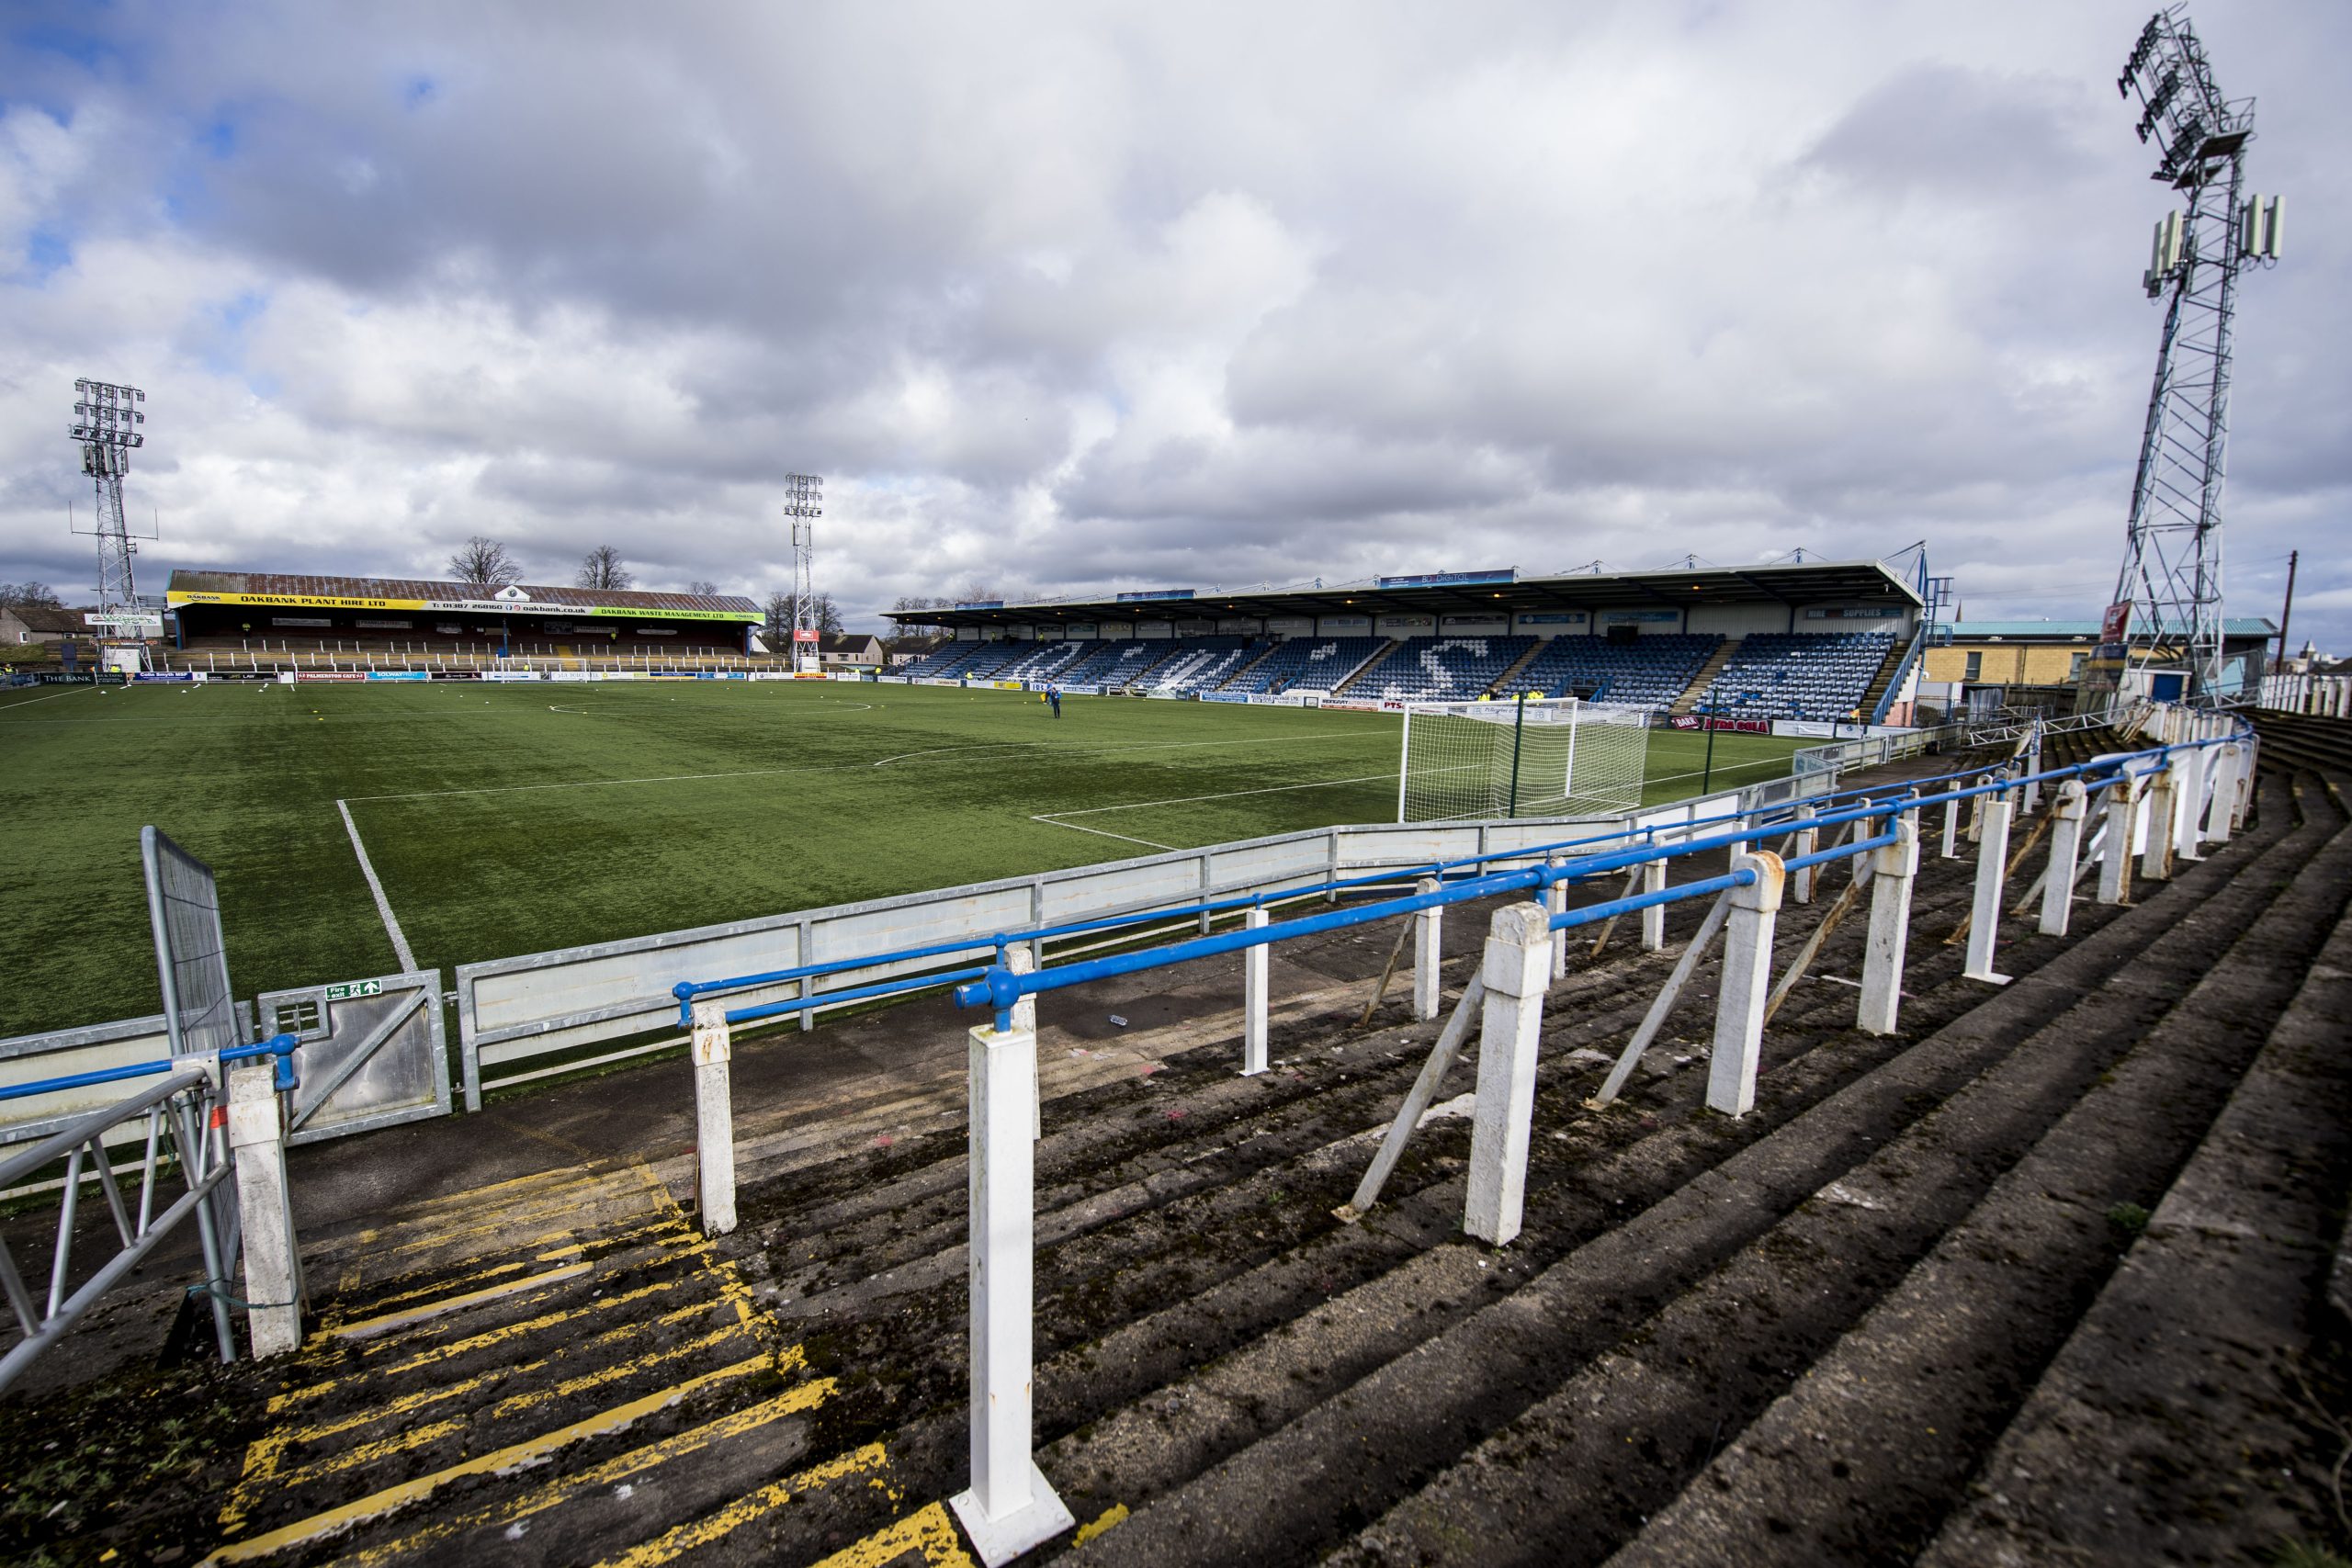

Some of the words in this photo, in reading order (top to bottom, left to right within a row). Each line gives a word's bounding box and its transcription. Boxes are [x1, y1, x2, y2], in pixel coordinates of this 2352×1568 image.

[241, 595, 297, 604] OAKBANK
[523, 605, 585, 614] oakbank.co.uk
[1842, 608, 1882, 617] SUPPLIES
[1384, 701, 1402, 709] PTS
[1676, 716, 1696, 728] BARR
[1736, 719, 1770, 735] COLA
